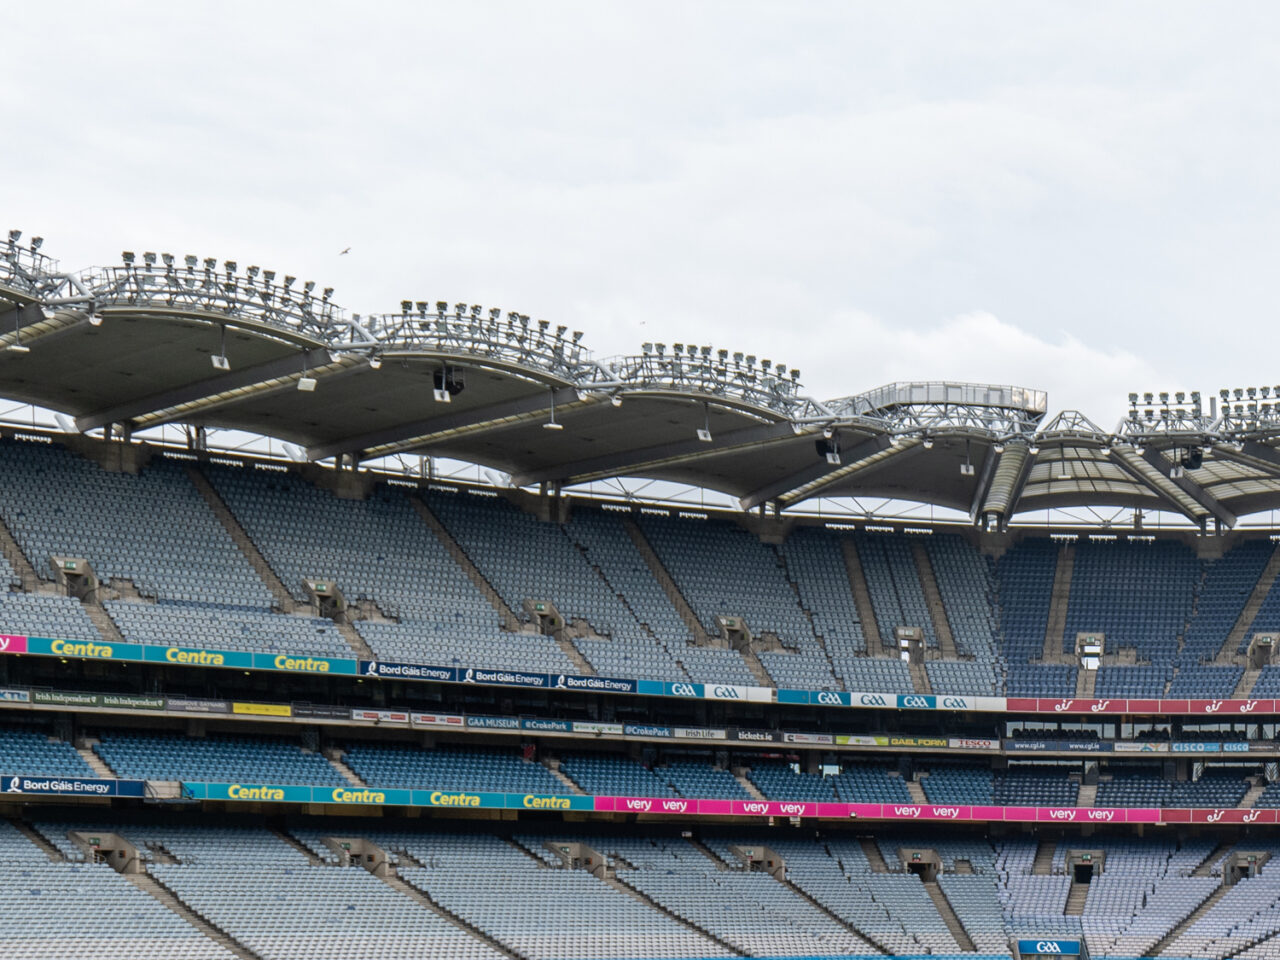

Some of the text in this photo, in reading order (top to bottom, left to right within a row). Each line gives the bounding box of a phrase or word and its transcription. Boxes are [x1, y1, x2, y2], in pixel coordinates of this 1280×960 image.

[51, 640, 113, 657] Centra
[166, 648, 224, 665] Centra
[274, 655, 330, 672] Centra
[379, 664, 451, 680] Bord Gáis Energy
[476, 671, 544, 686] Bord Gáis Energy
[567, 677, 632, 691] Bord Gáis Energy
[671, 683, 695, 696] GAA
[36, 693, 51, 701] Irish
[52, 694, 90, 703] Independent
[714, 686, 739, 699] GAA
[817, 692, 842, 705] GAA
[119, 698, 157, 707] Independent
[860, 694, 887, 706] GAA
[903, 695, 928, 708] GAA
[943, 697, 967, 710] GAA
[1055, 700, 1073, 712] eir
[1091, 700, 1109, 712] eir
[1205, 700, 1223, 713] eir
[1240, 700, 1258, 713] eir
[468, 718, 484, 726] GAA
[486, 719, 519, 728] MUSEUM
[525, 721, 567, 730] @CrokePark
[625, 727, 670, 737] @CrokePark
[738, 732, 773, 741] tickets.ie
[1172, 743, 1205, 751] CISCO
[1223, 743, 1249, 751] CISCO
[24, 780, 110, 794] Bord Gáis Energy
[228, 785, 284, 800] Centra
[332, 788, 385, 803] Centra
[430, 792, 480, 806] Centra
[523, 795, 571, 809] Centra
[627, 798, 652, 811] very
[662, 800, 688, 813] very
[743, 802, 769, 814] very
[780, 803, 805, 816] very
[894, 805, 921, 818] very
[933, 806, 959, 819] very
[1049, 808, 1077, 821] very
[1088, 809, 1114, 821] very
[1207, 809, 1225, 822] eir
[1243, 809, 1261, 822] eir
[1036, 942, 1061, 952] GAA
